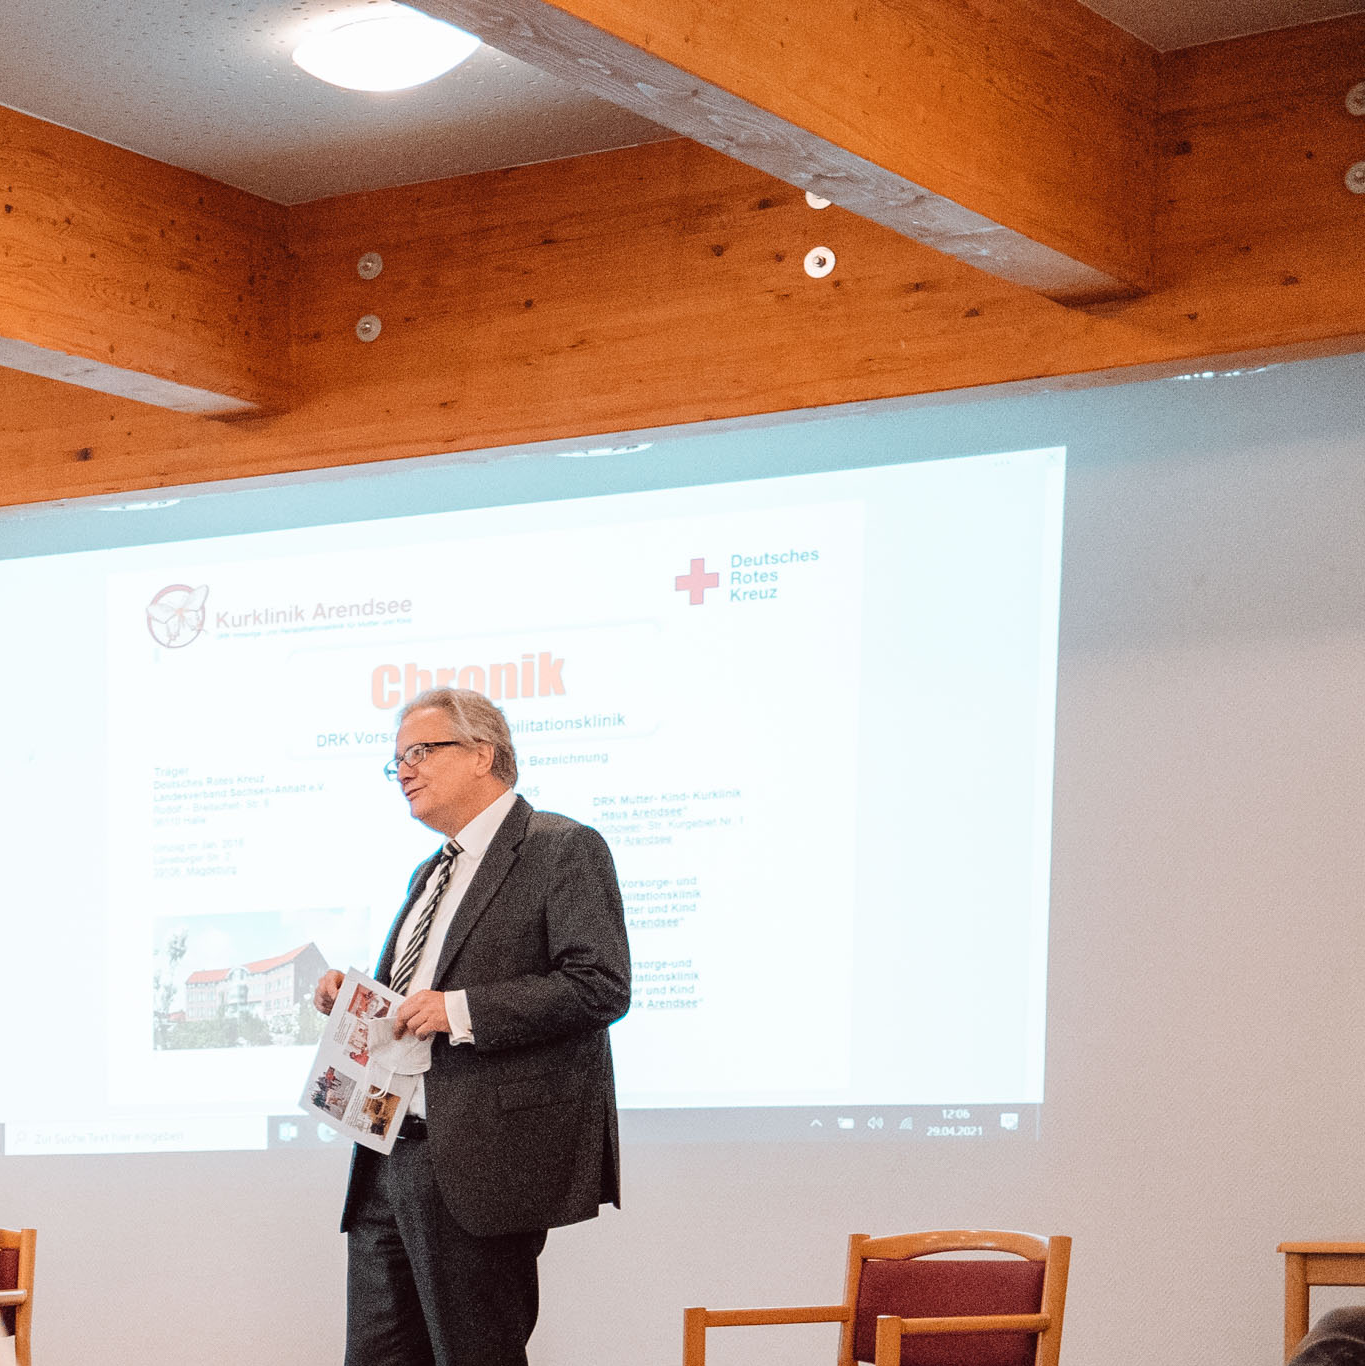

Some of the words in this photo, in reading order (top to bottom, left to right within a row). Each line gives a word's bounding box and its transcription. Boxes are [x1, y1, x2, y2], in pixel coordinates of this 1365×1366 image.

[730, 548, 820, 569] Deutsches
[730, 570, 779, 585] Rotes
[729, 586, 778, 602] Kreuz
[215, 604, 305, 629] Kurklinik
[312, 598, 413, 620] Arendsee
[316, 732, 350, 748] DRK
[354, 730, 397, 746] Vorso
[528, 752, 610, 768] Bezeichnung
[153, 778, 204, 790] Deutsches
[205, 775, 234, 786] Rotes
[236, 774, 265, 785] Kreuz
[153, 787, 227, 802] Landesverband
[592, 796, 616, 807] DRK
[692, 788, 742, 801] Kurklinik
[620, 878, 673, 890] Vorsorge-
[676, 875, 698, 887] und
[647, 903, 669, 915] und
[671, 902, 697, 914] Kind
[632, 958, 692, 971] rsorge-und
[645, 984, 667, 996] und
[669, 983, 696, 995] Kind
[941, 1108, 970, 1120] 12:06
[926, 1125, 983, 1137] 29.04.2021
